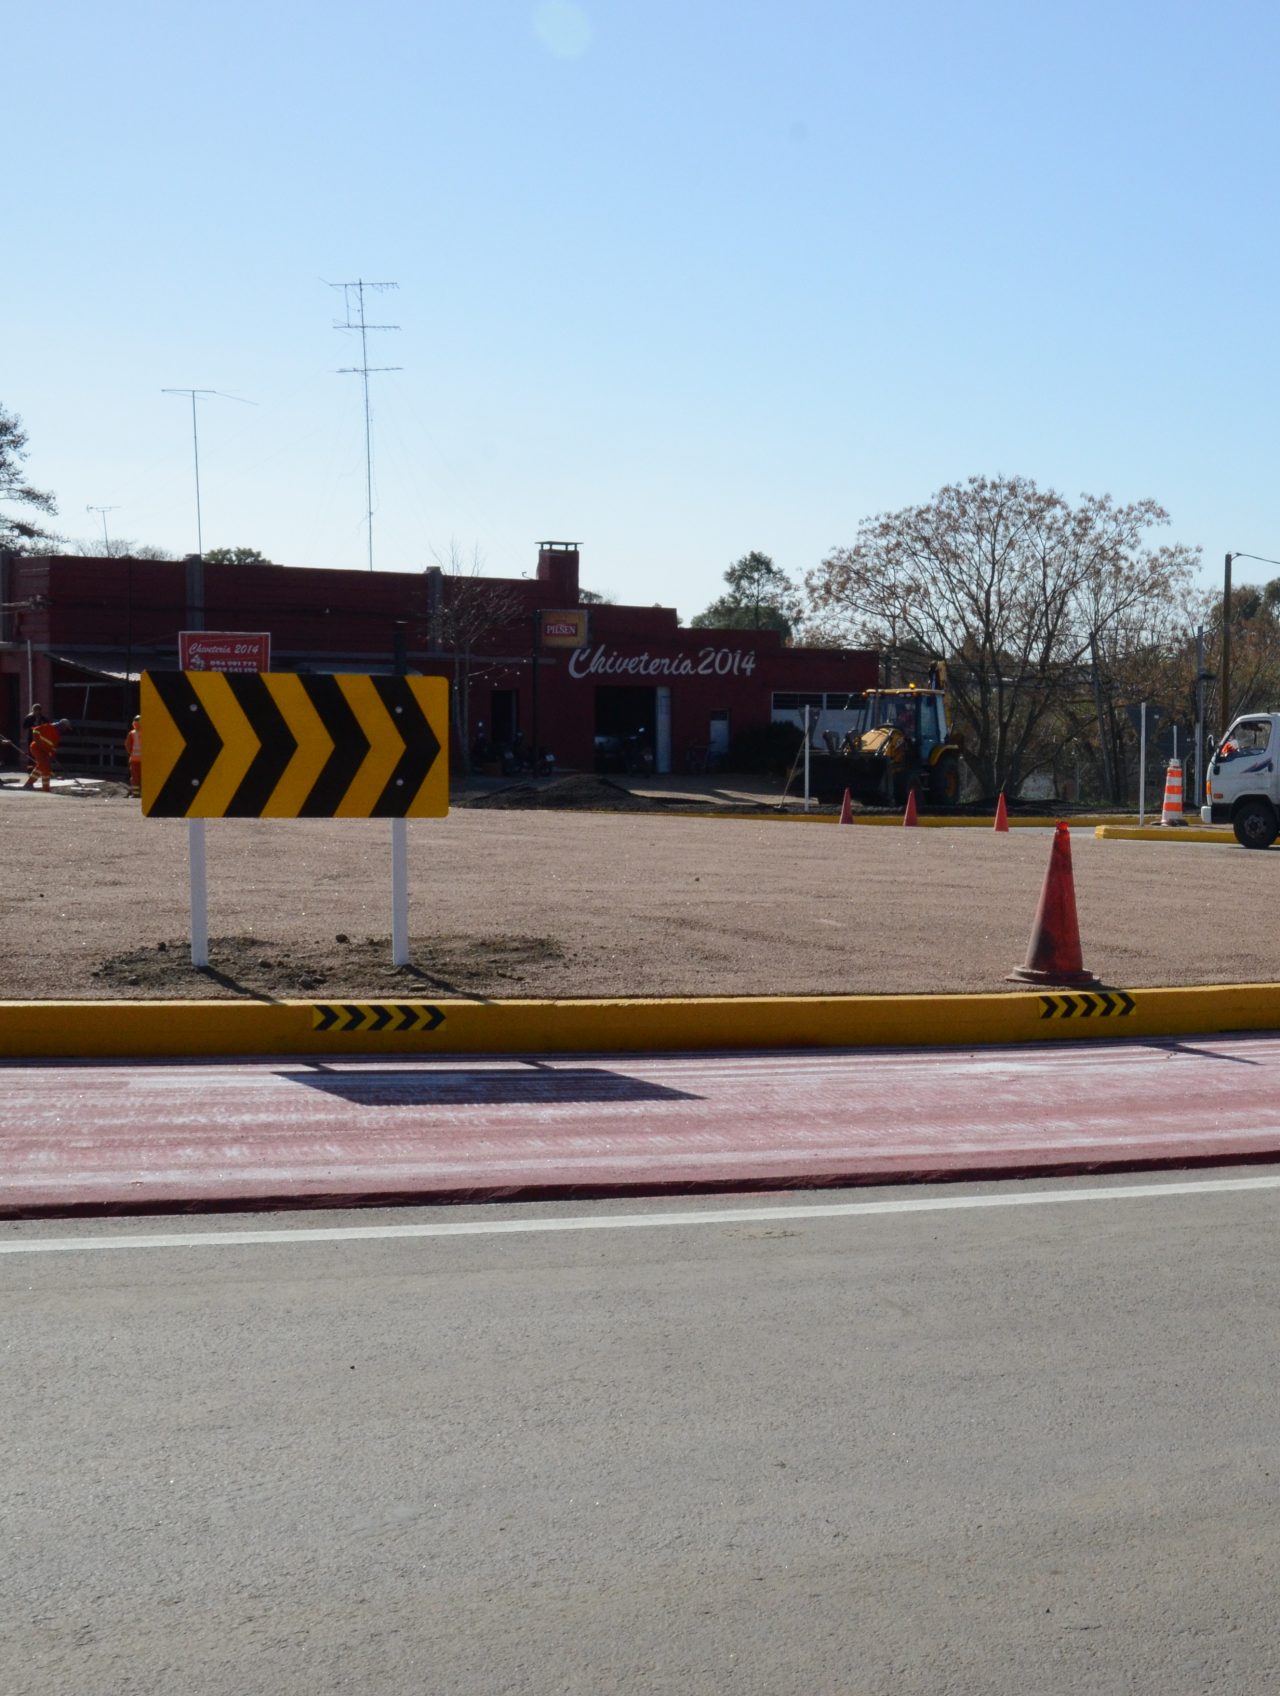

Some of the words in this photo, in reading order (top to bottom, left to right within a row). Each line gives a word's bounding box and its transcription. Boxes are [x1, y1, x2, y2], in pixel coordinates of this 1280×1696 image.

[546, 624, 576, 634] PILSEN
[234, 643, 259, 654] 2014
[697, 646, 756, 676] 2014
